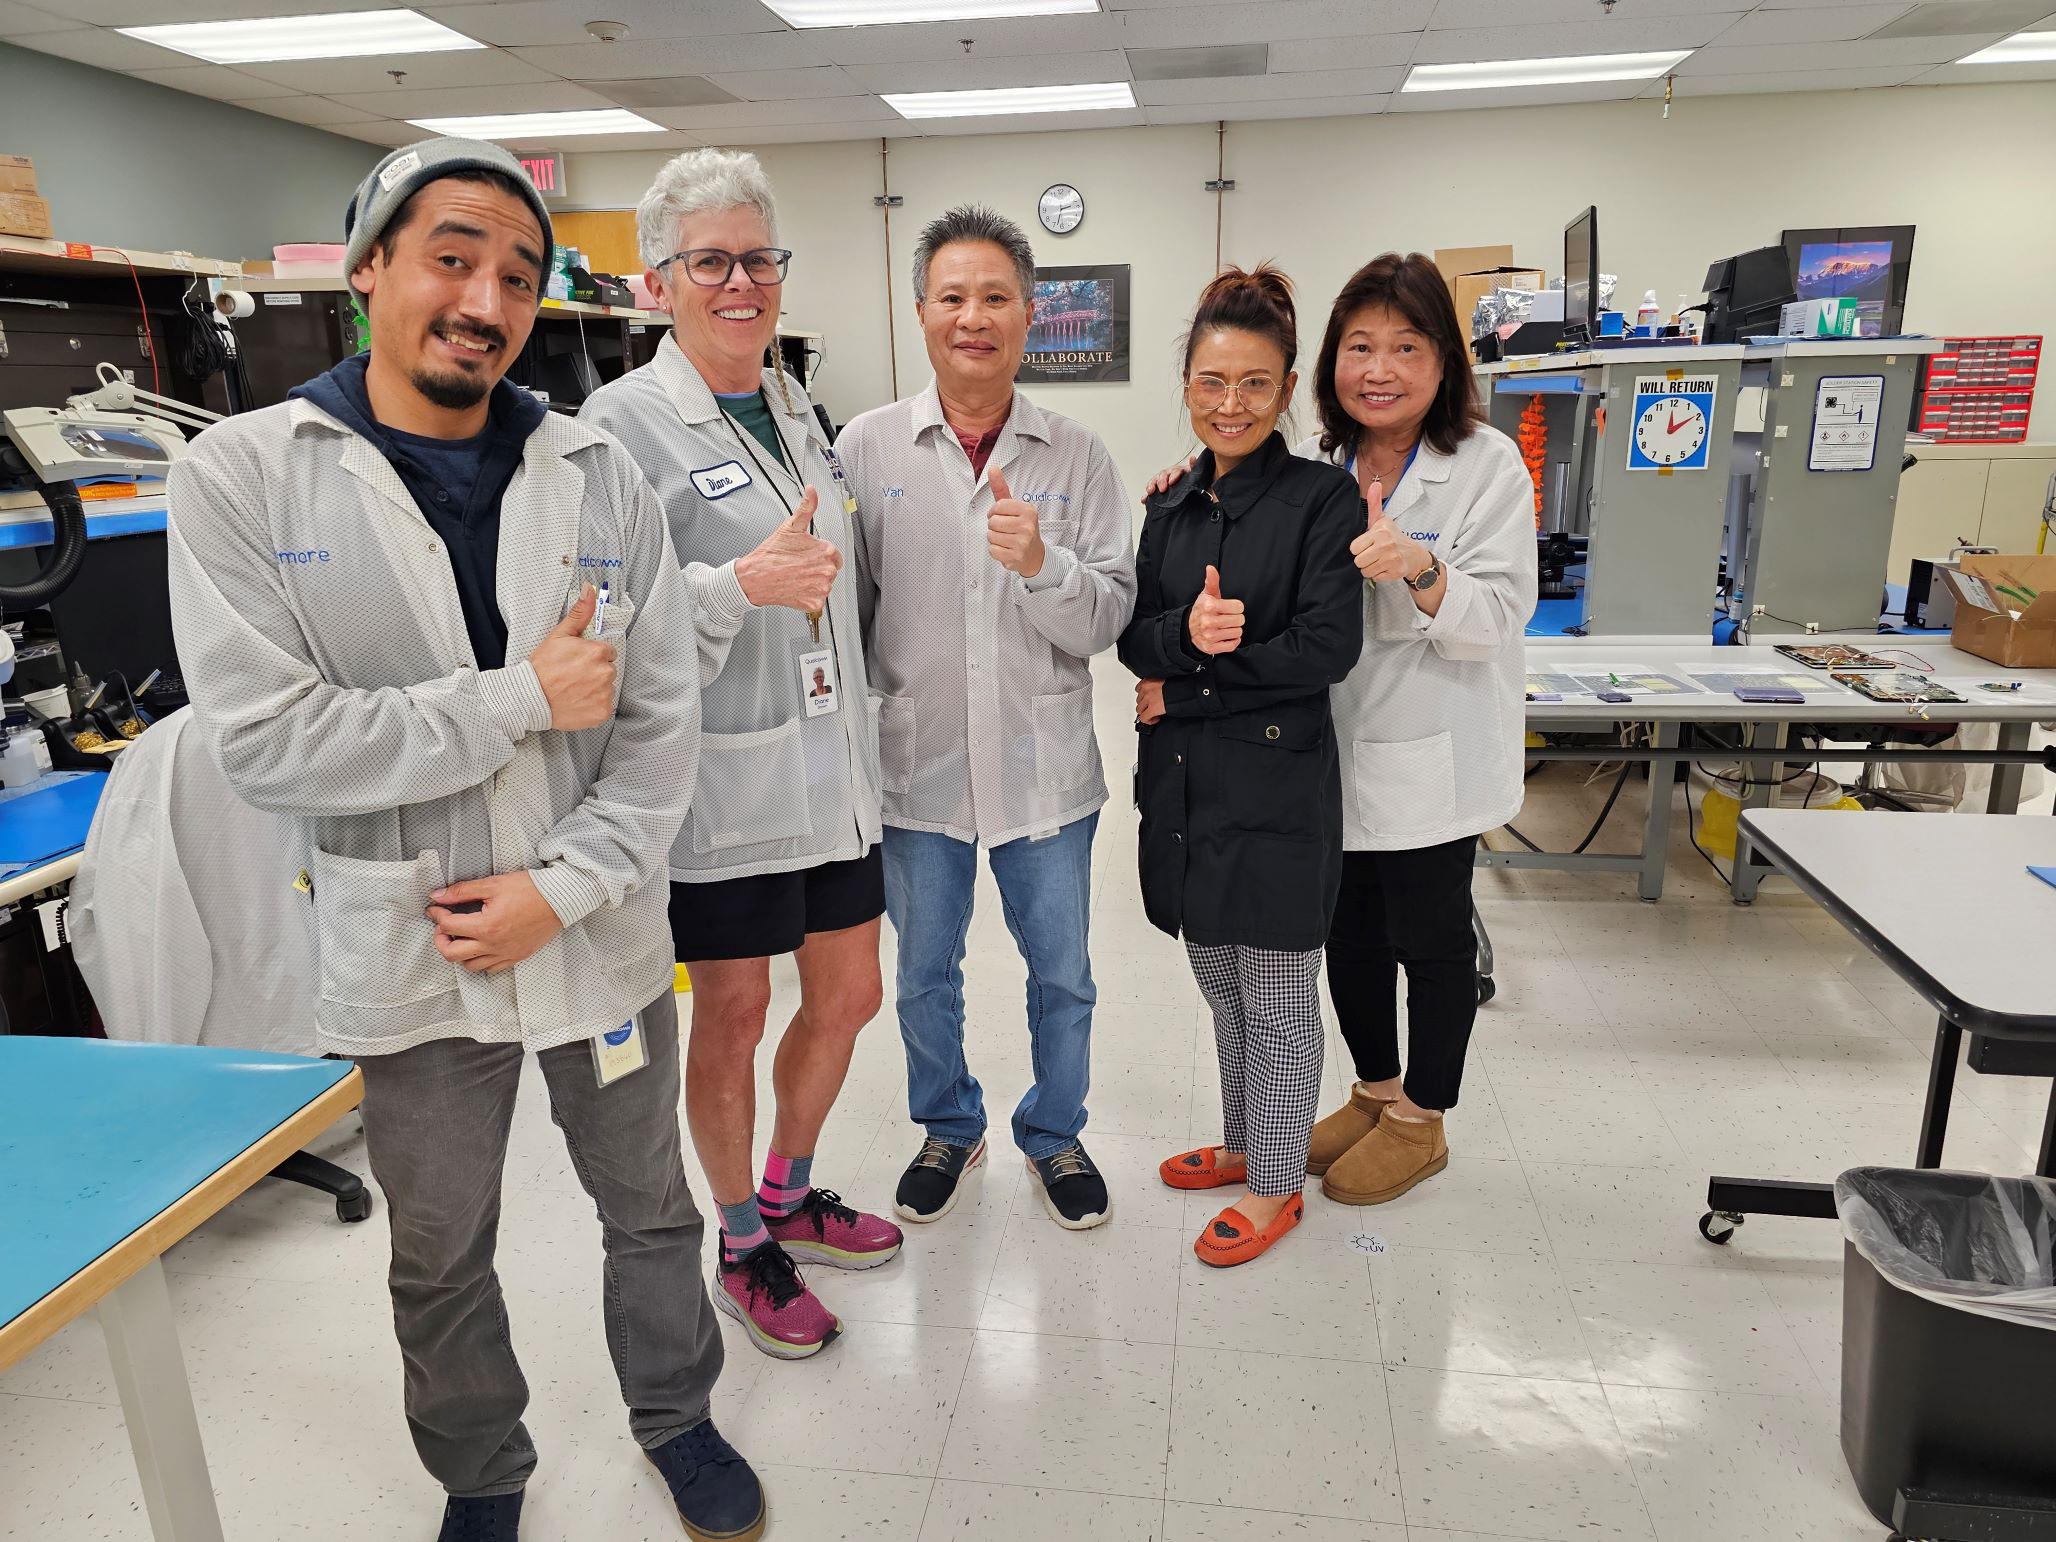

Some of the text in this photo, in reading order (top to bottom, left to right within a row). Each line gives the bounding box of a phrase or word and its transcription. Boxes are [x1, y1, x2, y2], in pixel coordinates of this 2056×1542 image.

[1021, 351, 1113, 364] OLLABORATE
[1640, 380, 1714, 394] WILL RETURN
[1655, 403, 1663, 412] 11
[1670, 399, 1679, 408] 12
[1686, 402, 1691, 411] 1
[1644, 413, 1653, 423] 10
[1695, 412, 1702, 421] 2
[1638, 427, 1644, 436] 9
[1698, 426, 1704, 435] 3
[1641, 441, 1647, 449] 8
[1691, 440, 1698, 449] 4
[1651, 450, 1657, 459] 7
[1665, 454, 1671, 463] 6
[1680, 450, 1686, 459] 5
[705, 476, 733, 492] Diane
[882, 487, 904, 497] Van
[1022, 491, 1071, 504] Qualcomm
[578, 553, 623, 568] alcomm
[1369, 1244, 1384, 1253] UV
